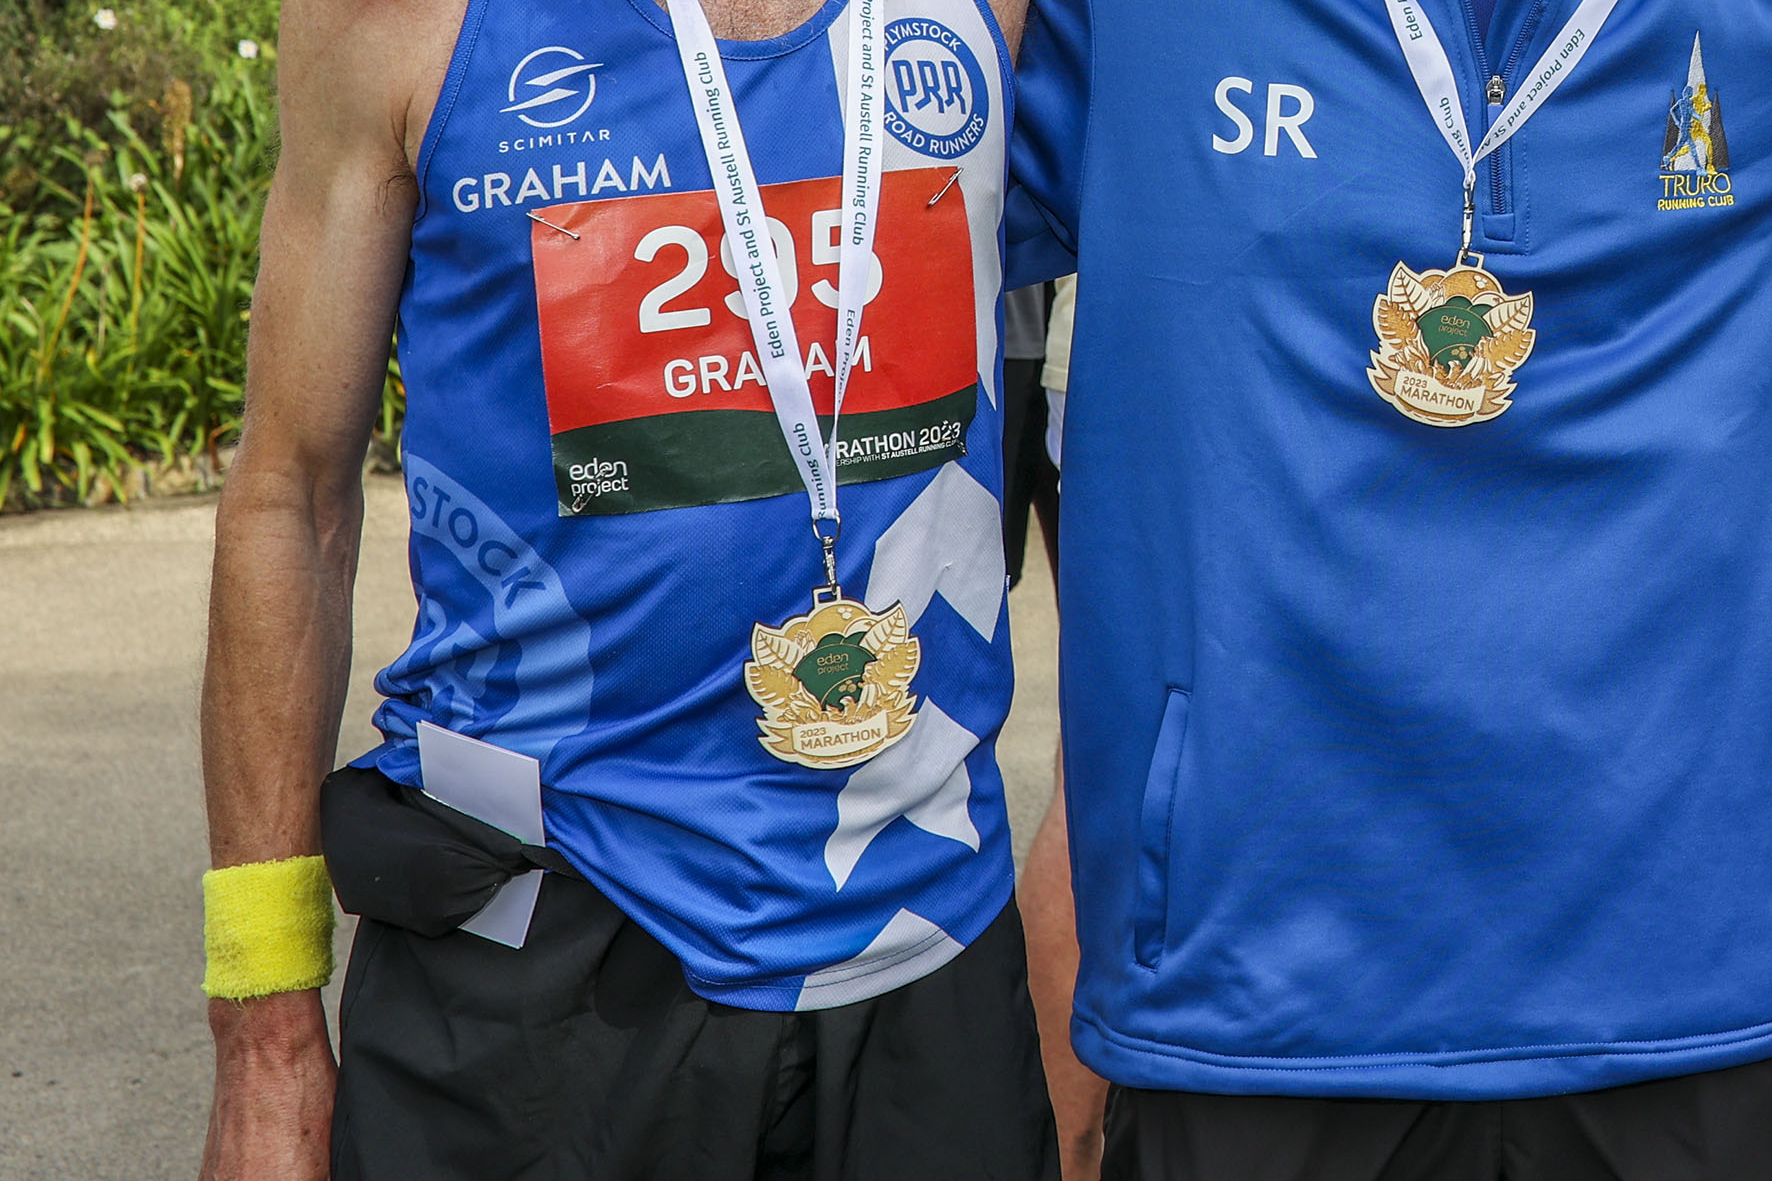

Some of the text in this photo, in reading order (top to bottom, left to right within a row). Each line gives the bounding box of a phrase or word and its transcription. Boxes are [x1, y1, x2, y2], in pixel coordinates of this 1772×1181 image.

[1403, 6, 1423, 41] Eden
[862, 43, 875, 71] and
[861, 74, 875, 89] St
[1493, 28, 1586, 138] Eden Project and St
[858, 92, 873, 142] Austell
[1212, 76, 1318, 159] SR
[1440, 97, 1454, 129] Club
[498, 129, 611, 154] SCIMITAR
[884, 111, 984, 155] ROAD RUNNERS
[452, 153, 672, 213] GRAHAM
[852, 146, 872, 208] Running
[1659, 172, 1732, 197] TRURO
[694, 52, 785, 359] Eden Project and St Austell Running Club
[1657, 194, 1735, 211] RUNNING CLUB
[852, 212, 867, 245] Club
[633, 208, 883, 333] 295
[845, 309, 856, 347] Eden
[1438, 314, 1471, 337] eden project
[663, 335, 872, 399] GRAAM
[1403, 376, 1428, 389] 2023
[1400, 385, 1475, 412] MARATHON
[1477, 408, 1562, 426] KARRIMOR
[836, 421, 961, 459] RATHON 2023
[881, 452, 891, 460] ST
[891, 447, 918, 459] AUSTELL
[918, 443, 945, 453] RUNNING
[568, 457, 628, 481] eden
[793, 422, 827, 519] Running Club
[570, 476, 630, 497] project
[816, 652, 849, 666] eden
[817, 663, 849, 675] project
[800, 727, 827, 739] 2023
[800, 728, 881, 751] MARATHON
